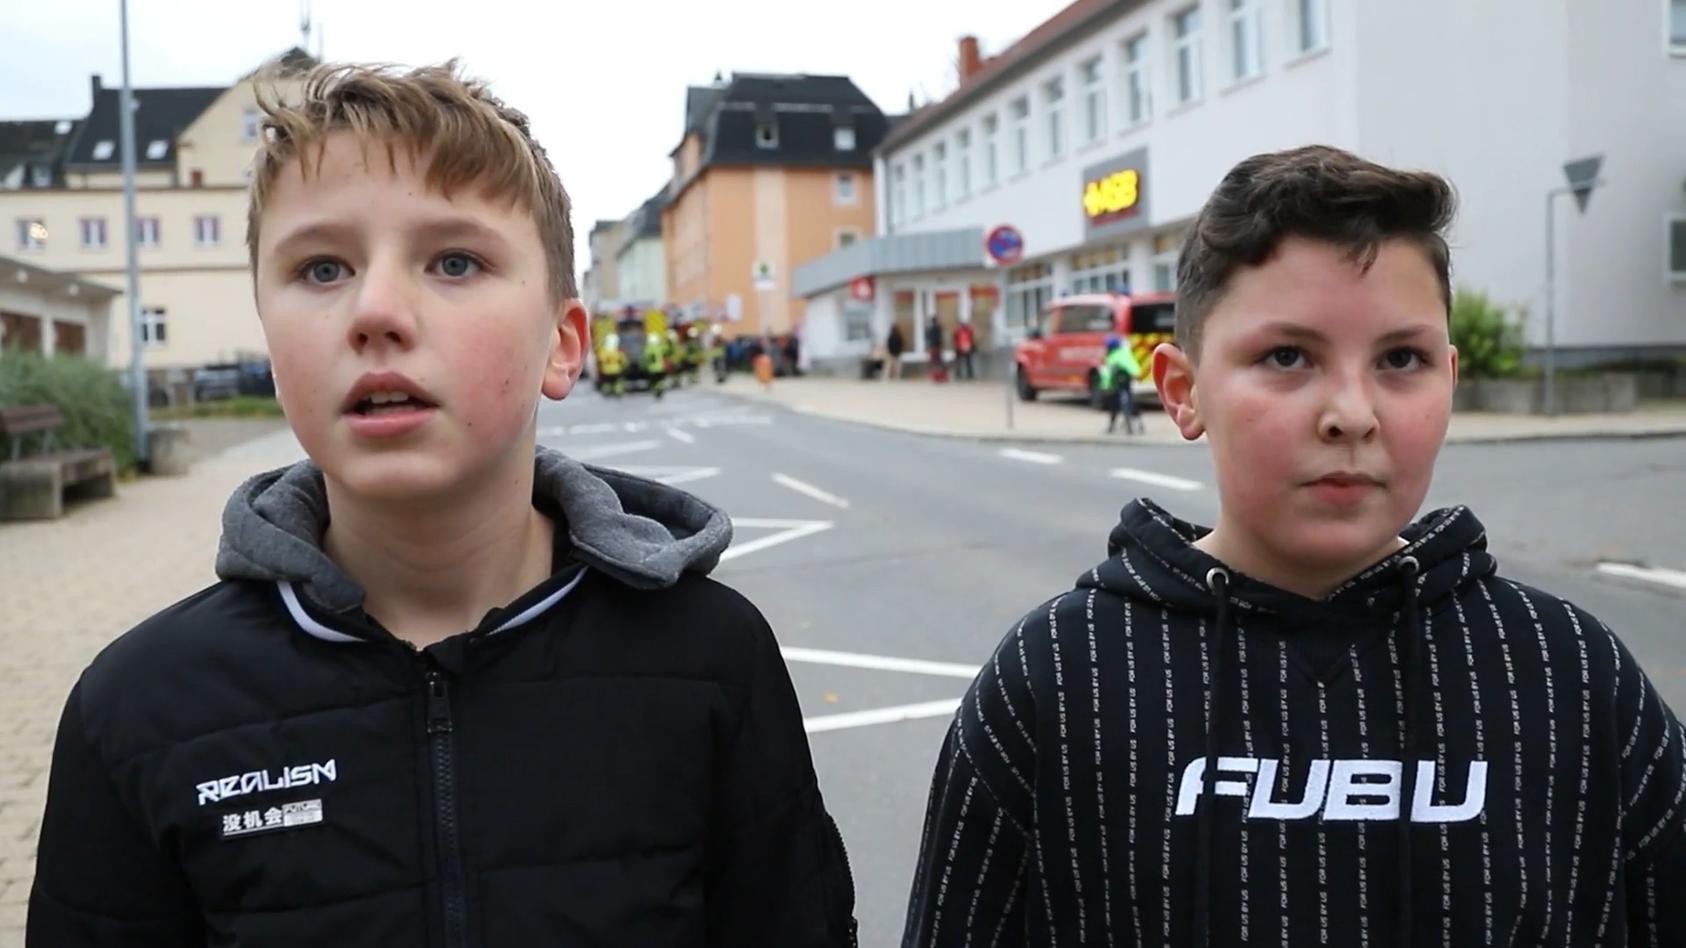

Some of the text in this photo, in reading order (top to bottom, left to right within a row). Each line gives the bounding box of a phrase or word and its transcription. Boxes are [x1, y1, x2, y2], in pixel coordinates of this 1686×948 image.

[196, 759, 337, 806] REALISM
[1175, 757, 1488, 822] FUBU
[222, 806, 282, 832] 没机会
